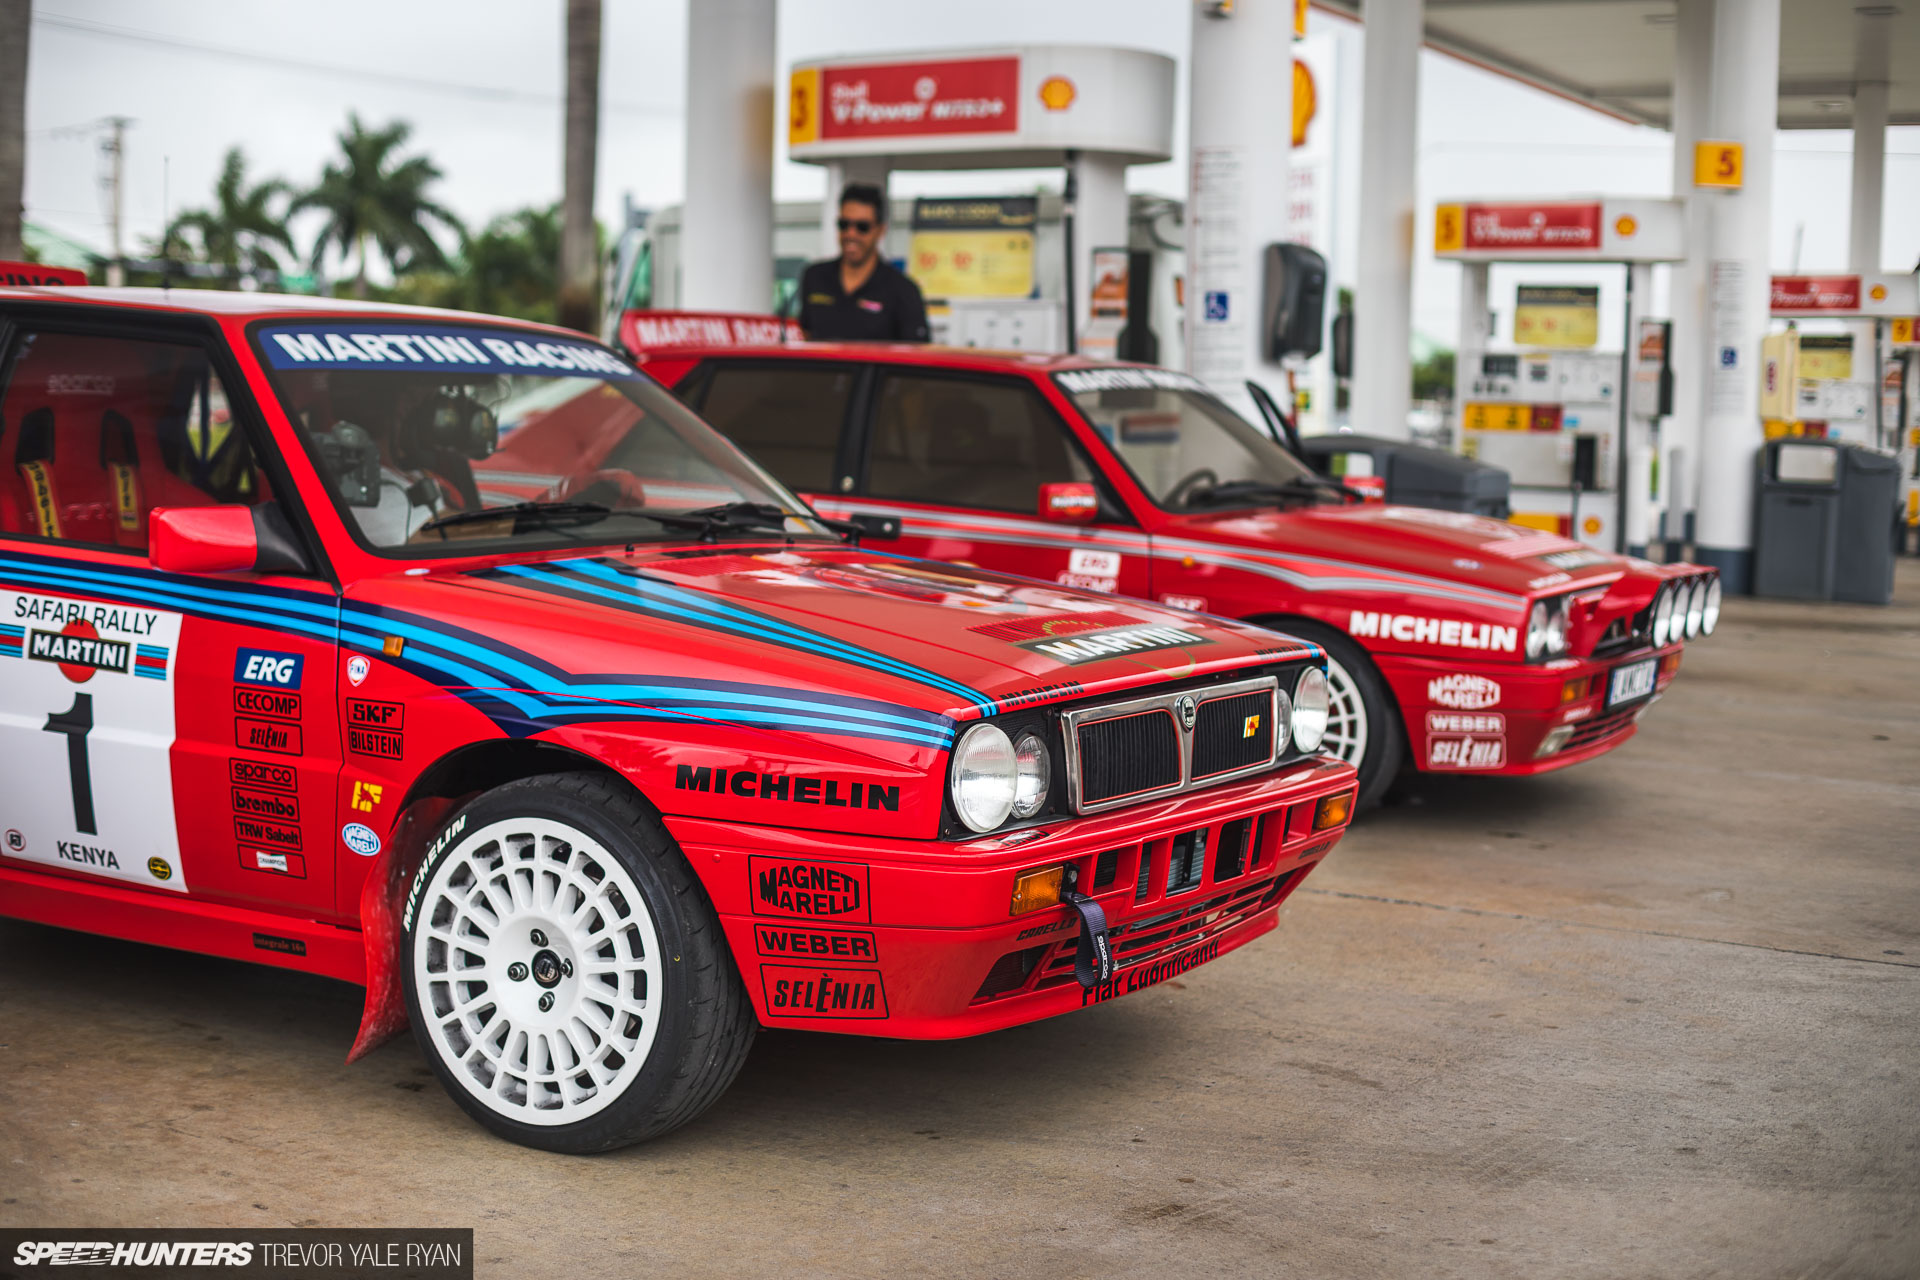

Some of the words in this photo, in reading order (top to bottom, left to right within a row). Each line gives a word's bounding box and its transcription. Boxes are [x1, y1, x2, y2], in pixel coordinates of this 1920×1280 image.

[1717, 149, 1736, 177] 5
[273, 333, 491, 364] MARTINI
[481, 338, 633, 376] RACING
[15, 596, 86, 627] SAFARI
[92, 606, 157, 635] RALLY
[1036, 626, 1202, 661] MARTINI
[1349, 610, 1518, 652] MICHELIN
[32, 634, 126, 669] MARTINI
[243, 655, 295, 683] ERG
[237, 691, 297, 715] CECOMP
[999, 680, 1084, 708] MICHELIN
[353, 703, 396, 723] SKF
[1431, 714, 1503, 732] WEBER
[350, 731, 401, 756] BILSTEIN
[43, 692, 97, 836] 1
[234, 763, 292, 785] sparco
[675, 764, 900, 811] MICHELIN
[235, 791, 295, 817] brembo
[237, 821, 263, 838] TRW
[265, 826, 299, 846] Sabelt
[57, 840, 120, 870] KENYA
[403, 814, 466, 933] MICHELIN
[759, 865, 860, 899] MAGNETI
[760, 887, 860, 915] MARELLI
[761, 931, 871, 957] WEBER
[1096, 935, 1109, 981] sparco
[1082, 974, 1122, 1006] Fiat
[1127, 934, 1222, 993] Lubrificanti
